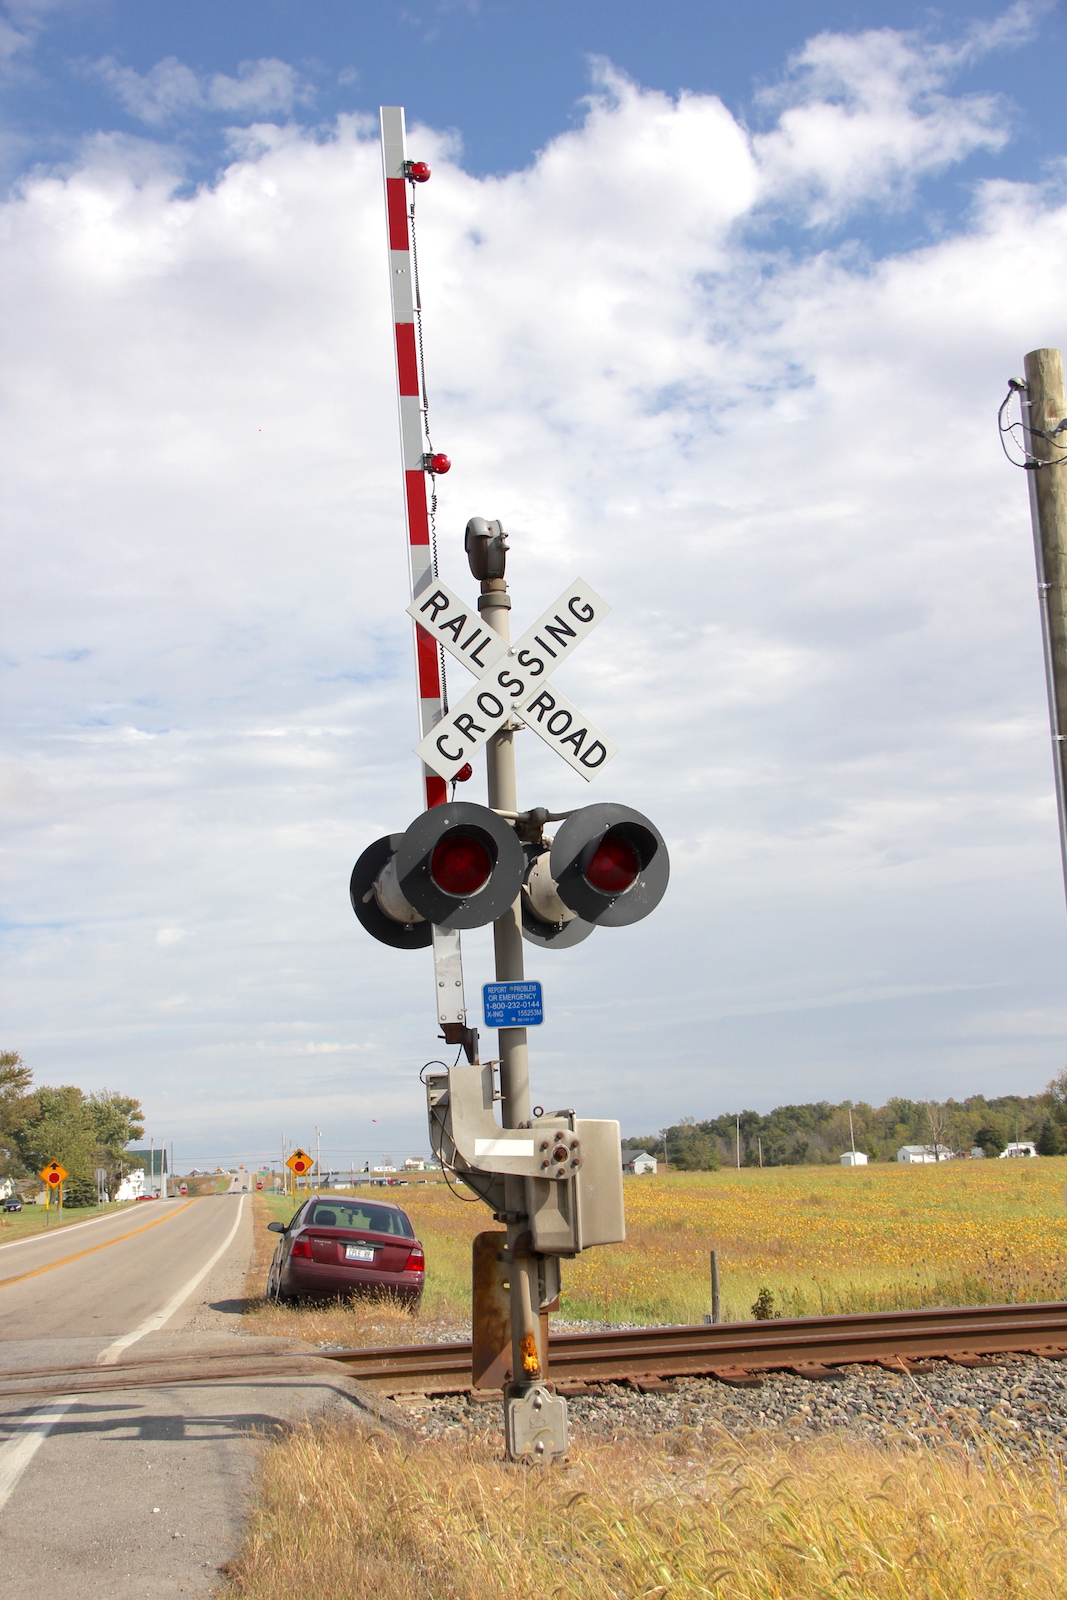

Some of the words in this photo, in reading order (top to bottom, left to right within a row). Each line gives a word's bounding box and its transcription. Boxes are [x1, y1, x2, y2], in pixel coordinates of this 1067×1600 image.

[419, 589, 492, 669] RAIL
[526, 690, 608, 769] ROAD
[436, 595, 595, 762] CROSSING
[486, 1001, 540, 1010] 1-800-232-0144
[498, 993, 537, 1001] EMERGENCY
